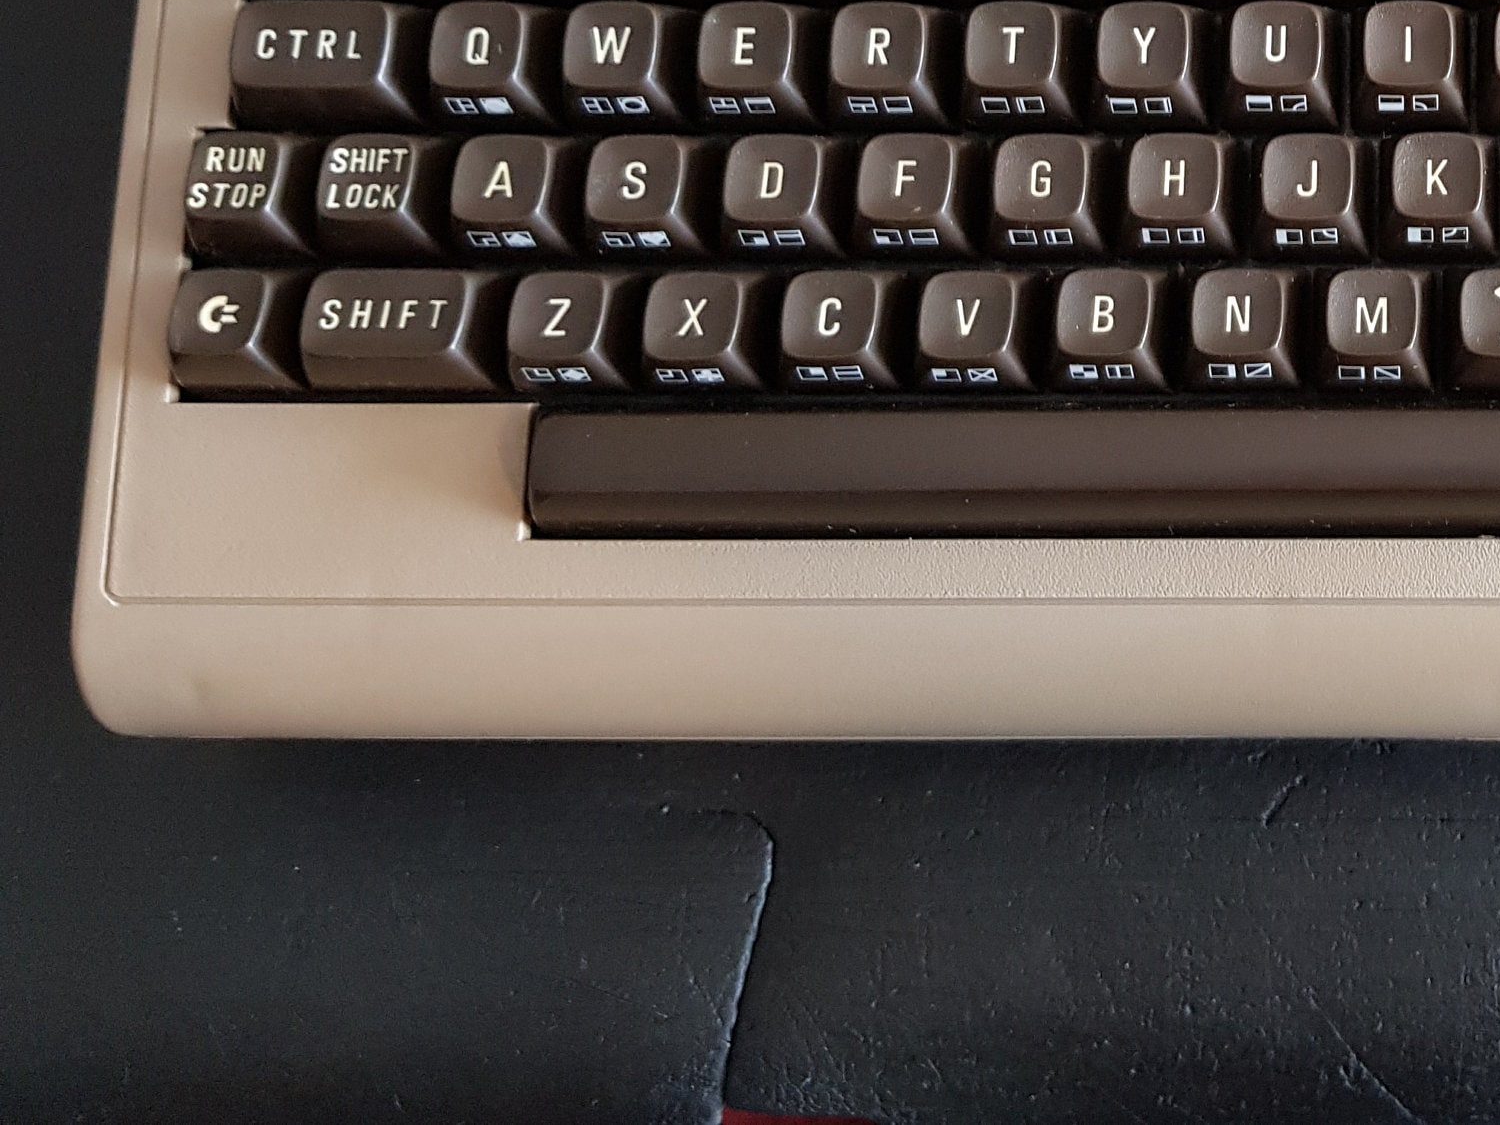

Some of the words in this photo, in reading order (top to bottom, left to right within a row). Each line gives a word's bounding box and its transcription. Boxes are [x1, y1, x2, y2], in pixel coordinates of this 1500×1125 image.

[257, 28, 361, 59] CTRL
[465, 26, 490, 65] Q
[592, 26, 631, 64] W
[733, 27, 756, 65] E
[867, 27, 891, 65] R
[1002, 26, 1025, 64] T
[1133, 27, 1156, 64] Y
[1265, 25, 1287, 63] U
[1404, 26, 1412, 63] I
[204, 146, 266, 172] RUN
[329, 147, 408, 174] SHIFT
[1163, 159, 1186, 196] H
[1426, 159, 1448, 196] K
[187, 182, 267, 210] STOP
[326, 183, 400, 210] LOCK
[483, 161, 513, 198] A
[622, 161, 647, 200] S
[759, 162, 784, 199] D
[894, 160, 917, 197] F
[1030, 160, 1052, 198] G
[1296, 160, 1318, 197] J
[319, 299, 447, 330] SHIFT
[543, 298, 571, 337] Z
[677, 298, 707, 336] X
[817, 297, 842, 337] C
[956, 298, 981, 336] V
[1091, 295, 1115, 333] B
[1225, 295, 1251, 333] N
[1355, 296, 1388, 334] M
